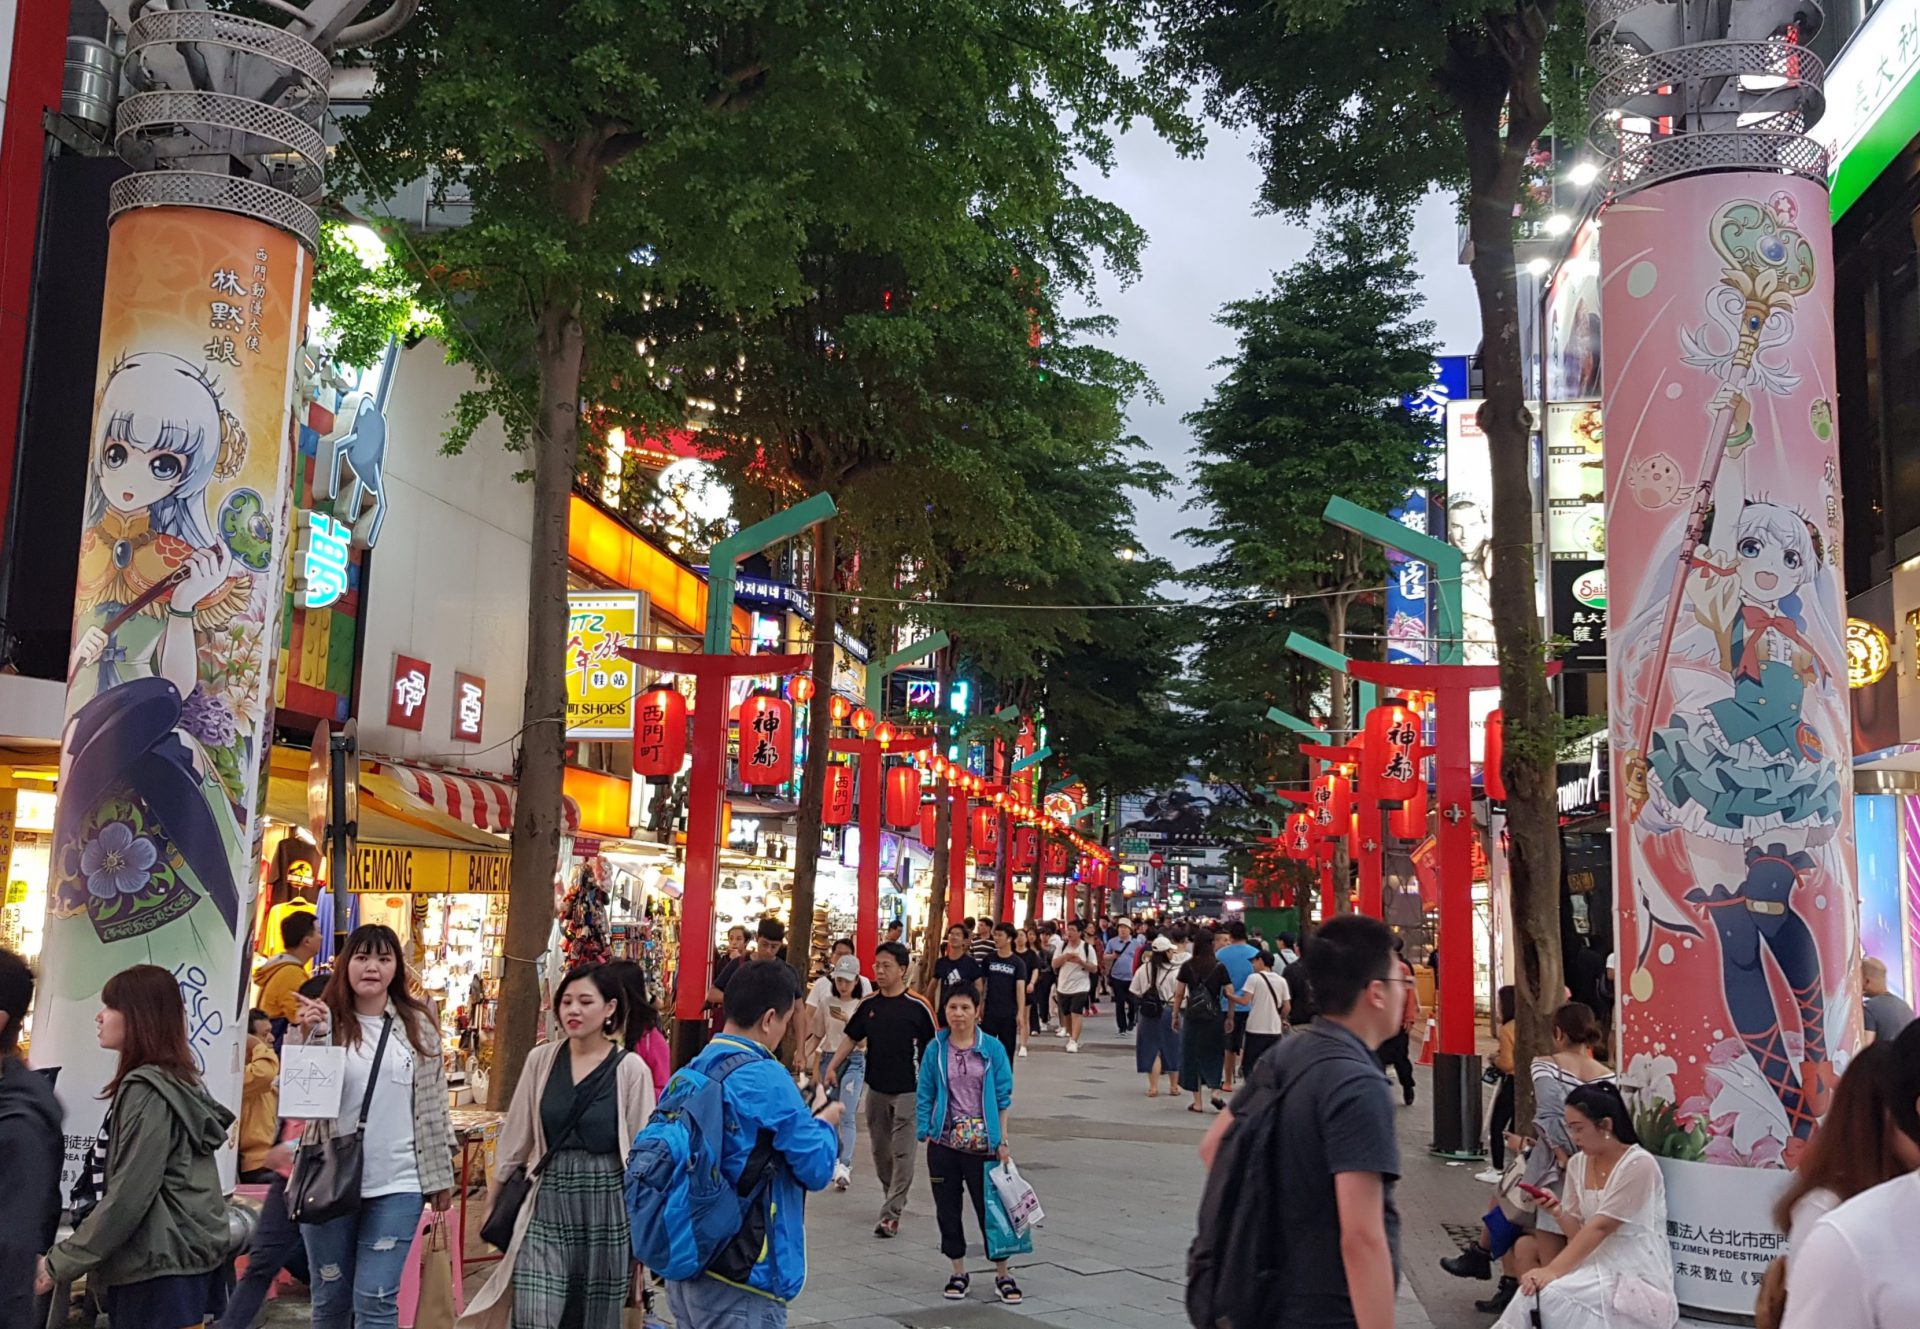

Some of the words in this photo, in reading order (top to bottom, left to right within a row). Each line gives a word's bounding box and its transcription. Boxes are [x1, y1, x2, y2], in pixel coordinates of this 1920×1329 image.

[245, 248, 268, 353] 西門動漫大使
[581, 702, 626, 715] SHOES
[640, 704, 665, 763] 西門町
[750, 709, 781, 769] 神都
[1381, 721, 1417, 783] 神都
[832, 776, 849, 816] 西門町
[1314, 785, 1332, 826] 神都
[1293, 821, 1310, 852] 神都
[329, 848, 412, 891] IKEMONG
[989, 962, 1015, 974] adidas
[1681, 1244, 1710, 1256] XIMEN
